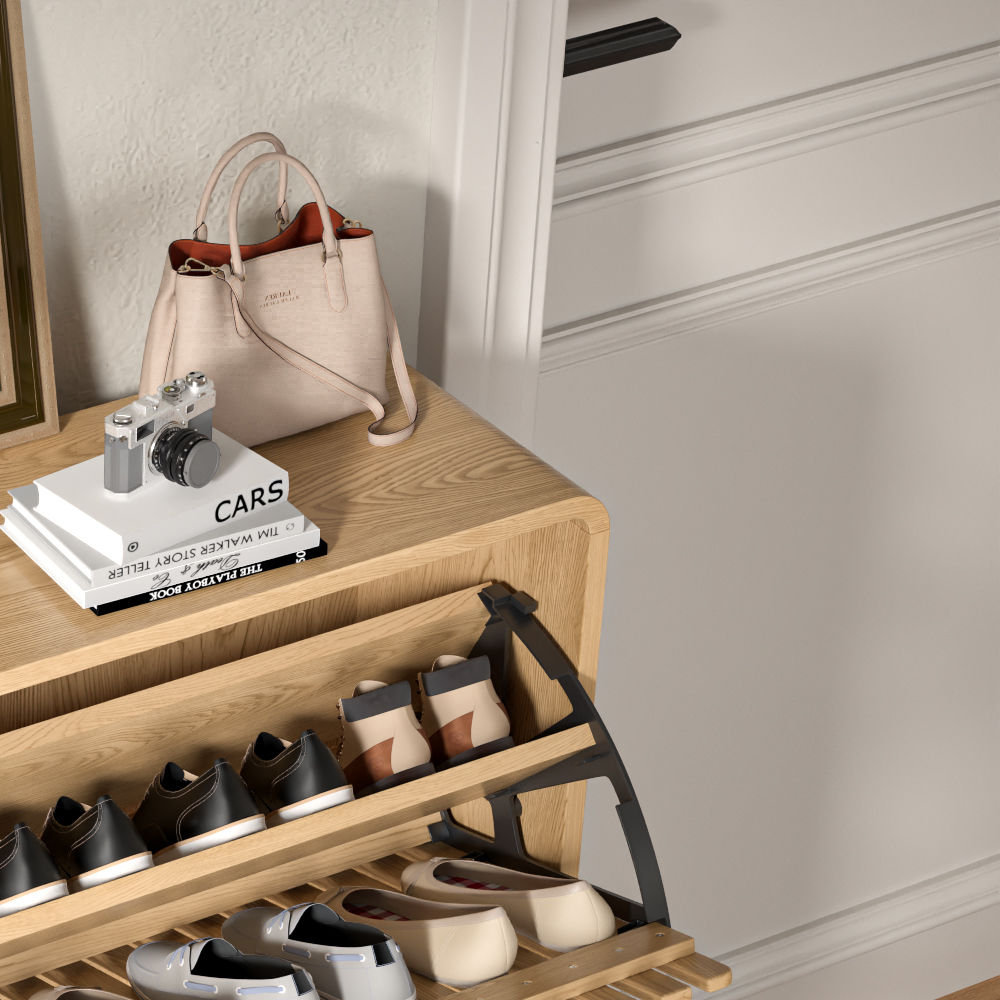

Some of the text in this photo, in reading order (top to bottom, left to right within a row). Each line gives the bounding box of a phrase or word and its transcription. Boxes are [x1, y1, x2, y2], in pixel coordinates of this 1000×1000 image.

[215, 480, 284, 523] CARS
[108, 526, 279, 580] TIM WALKER STORY TELLER
[190, 552, 241, 578] Death
[149, 563, 263, 601] THE PLAYBOY BOOK
